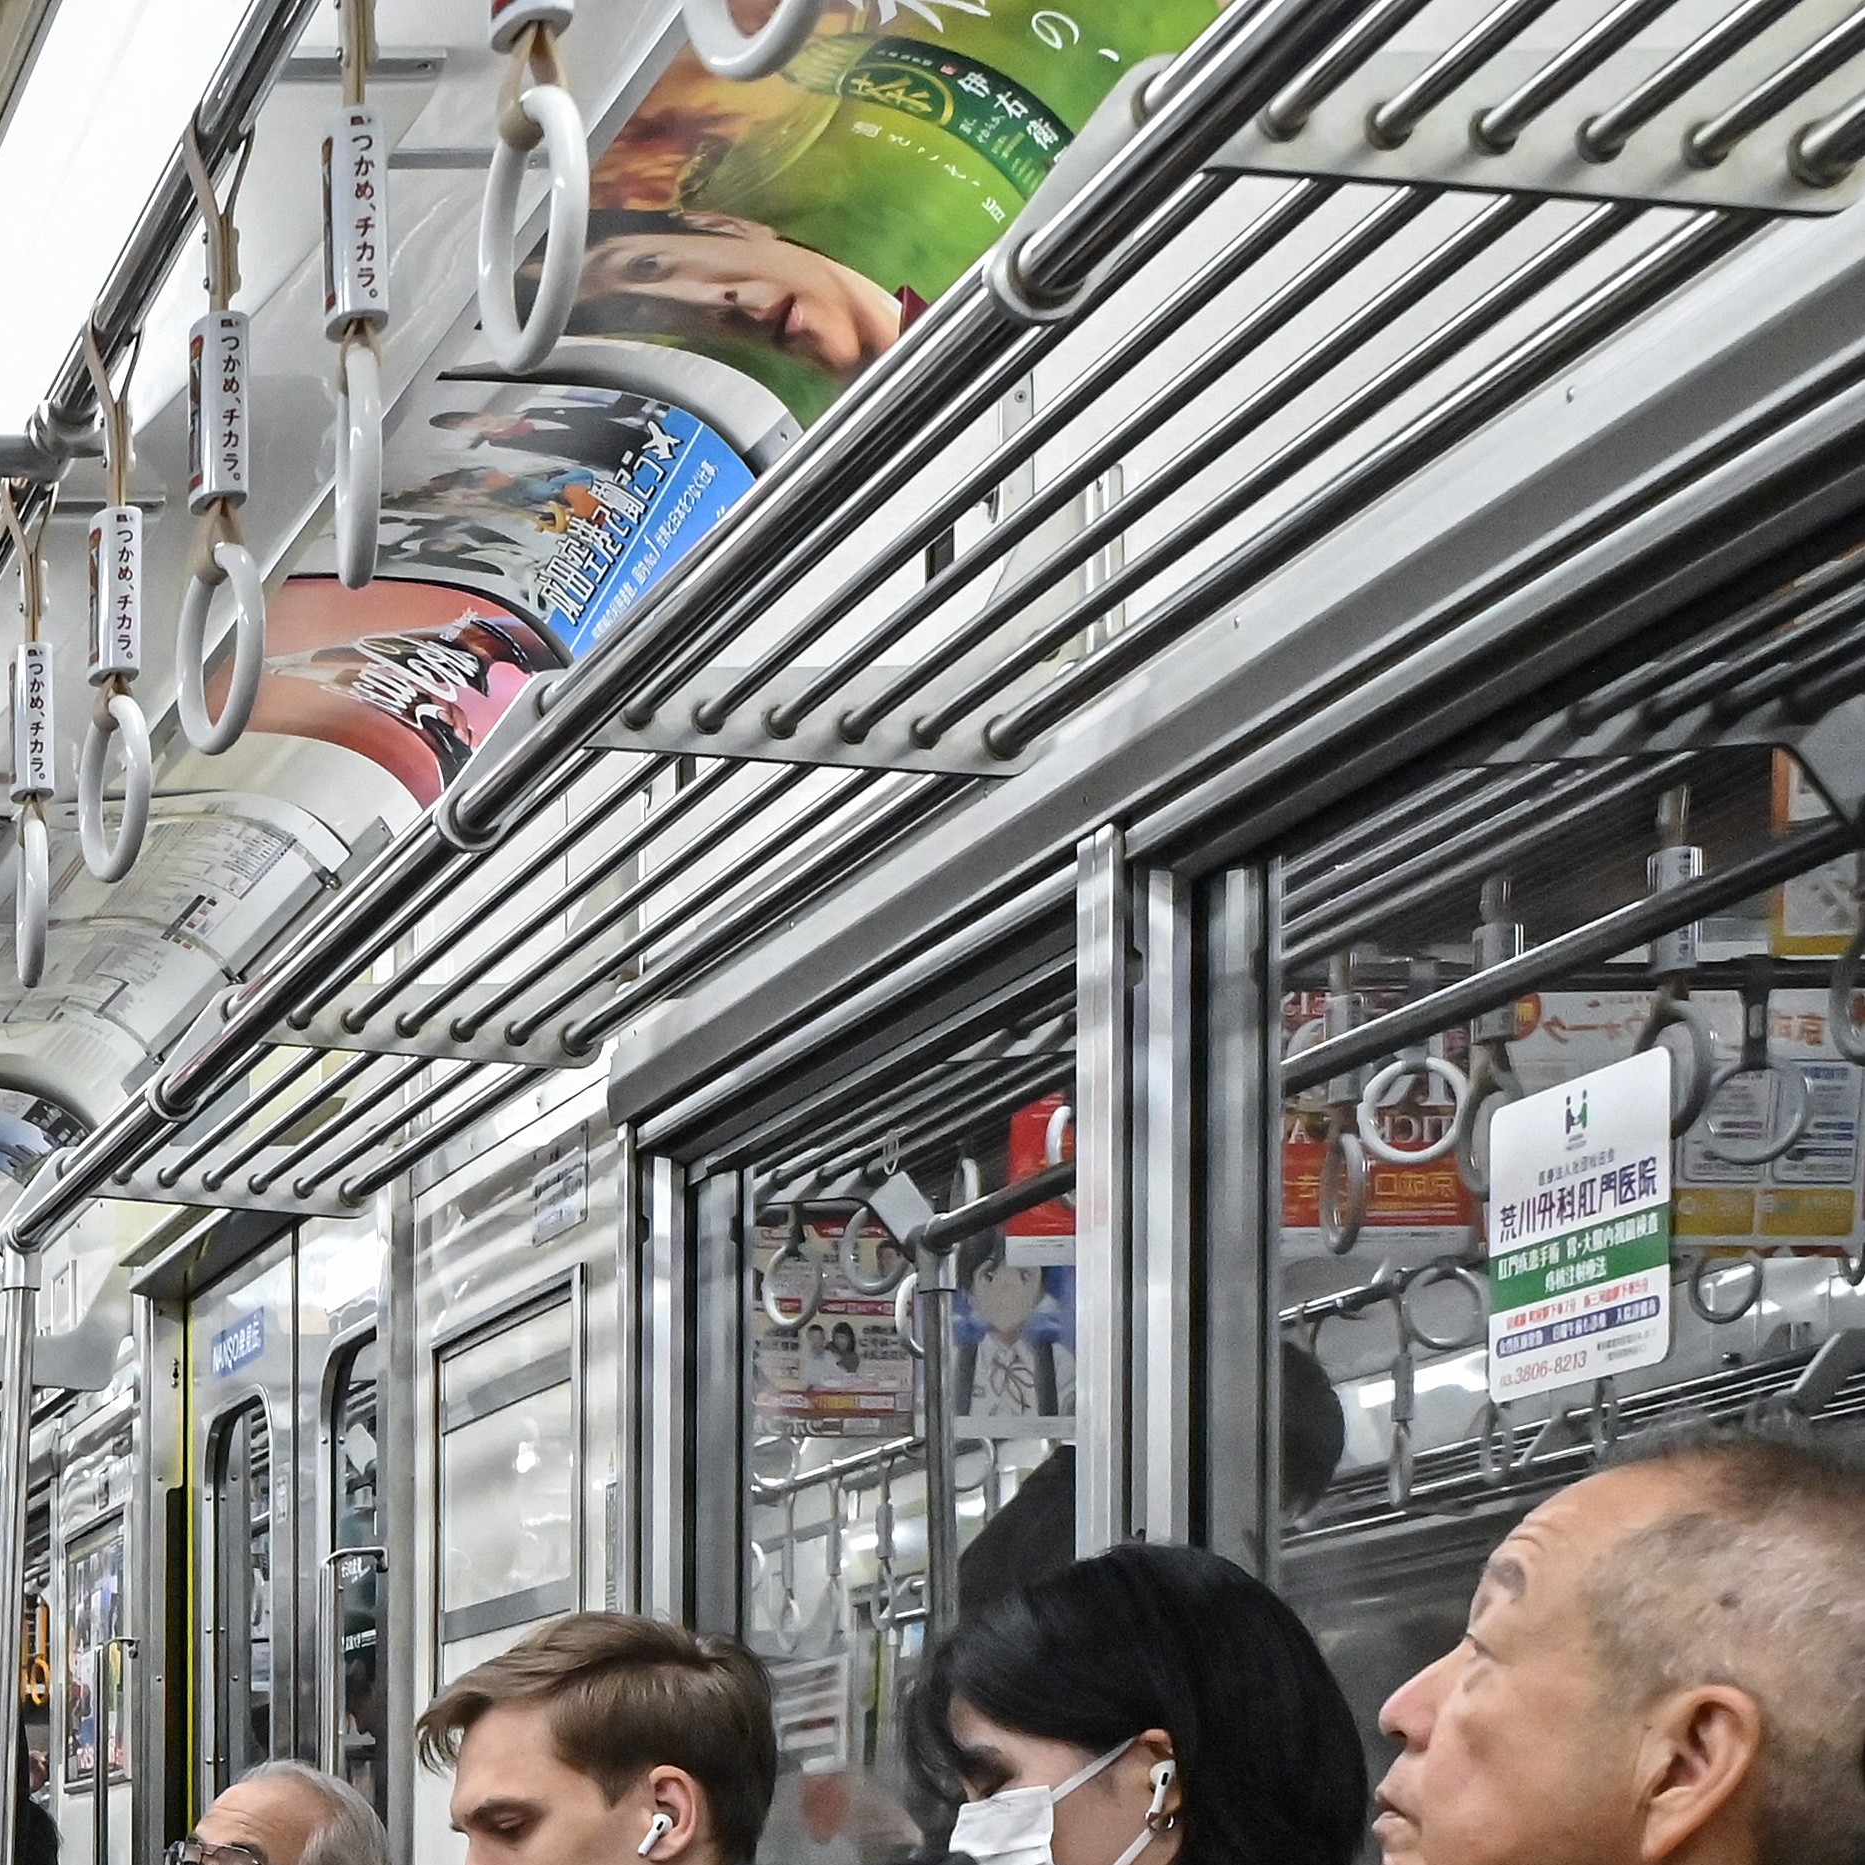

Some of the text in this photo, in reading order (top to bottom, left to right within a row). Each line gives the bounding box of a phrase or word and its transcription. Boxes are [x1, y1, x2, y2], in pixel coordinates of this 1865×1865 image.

[352, 136, 378, 299] つかめ、チカラ。
[221, 333, 241, 482] つかめ、チカラ。
[117, 530, 134, 660] つかめ、チカラ。
[536, 451, 666, 625] 成田空港で働こう
[29, 660, 46, 780] つかめ、チカラ。
[1500, 1156, 1657, 1243] 荒川外科肛門医院
